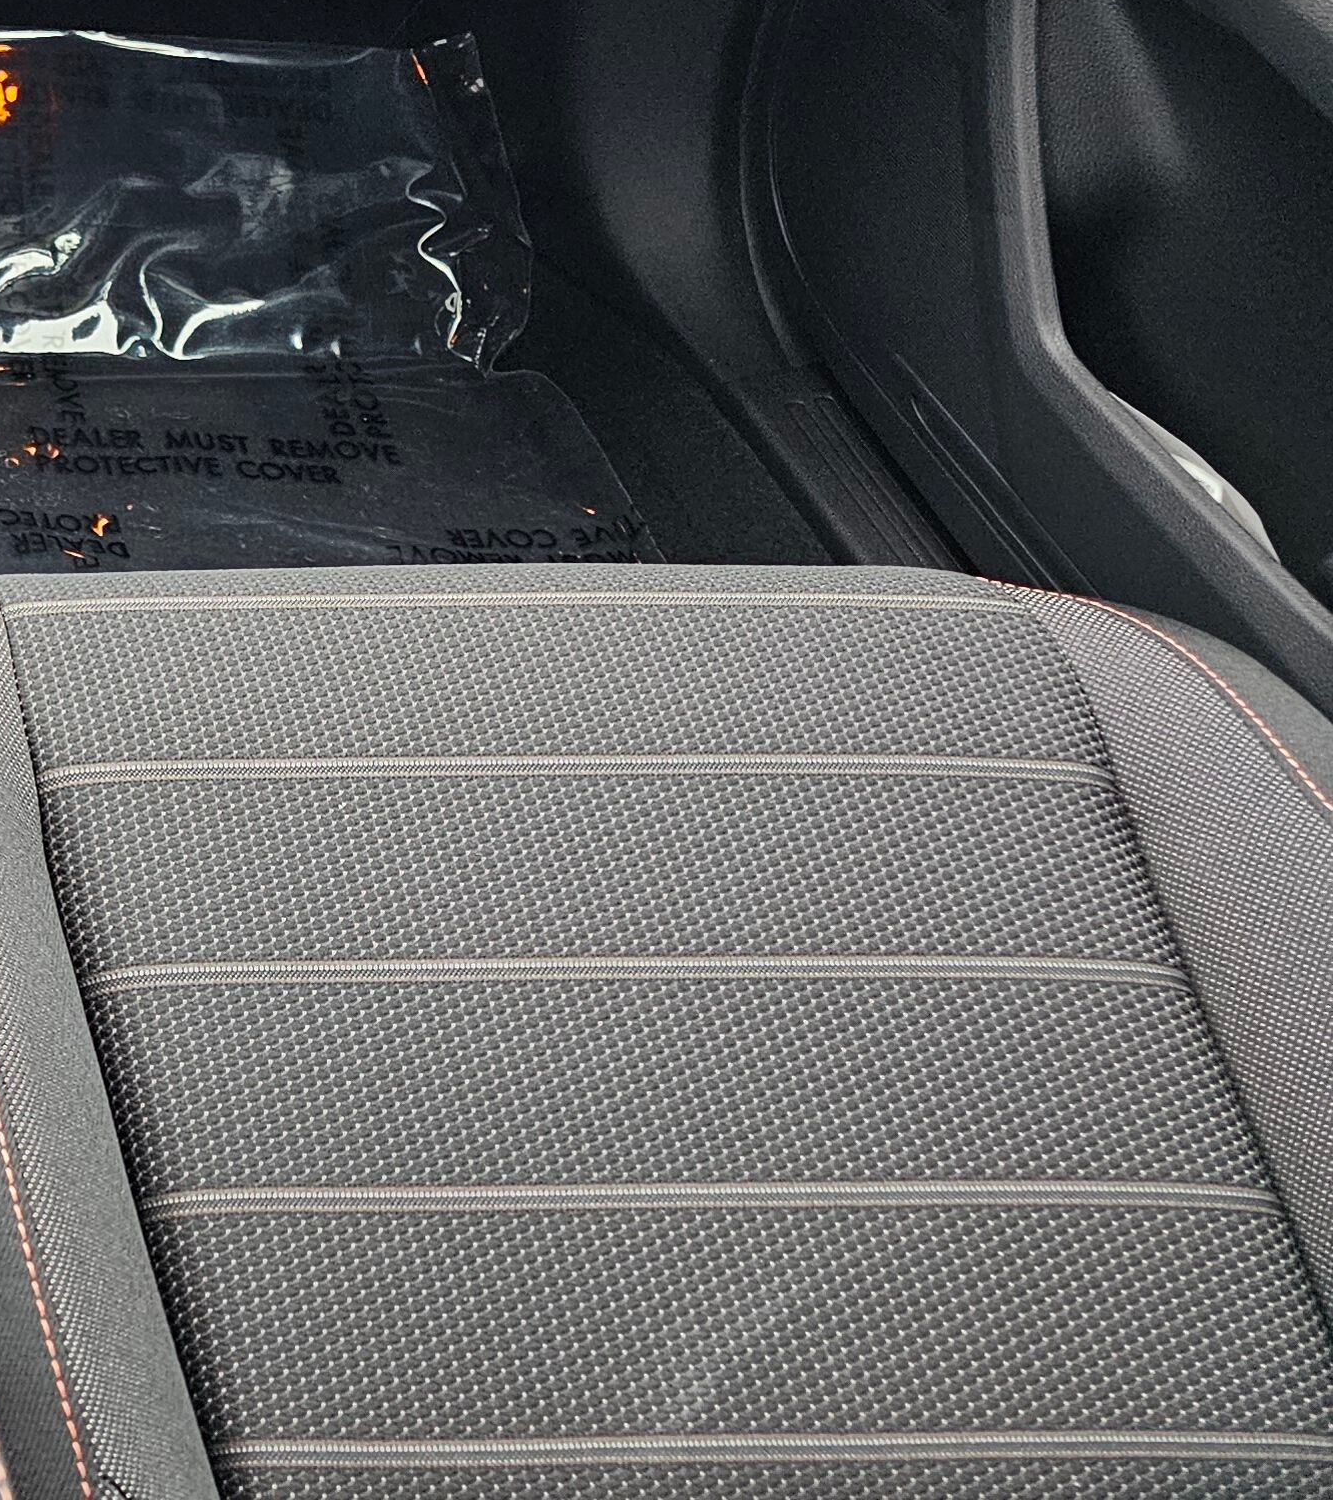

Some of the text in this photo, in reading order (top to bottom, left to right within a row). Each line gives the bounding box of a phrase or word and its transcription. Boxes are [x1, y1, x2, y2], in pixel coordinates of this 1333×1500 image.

[30, 426, 401, 466] DEALER MUST REMOVE
[36, 454, 343, 485] PROTECTIVE COVER
[445, 527, 557, 549] COVER
